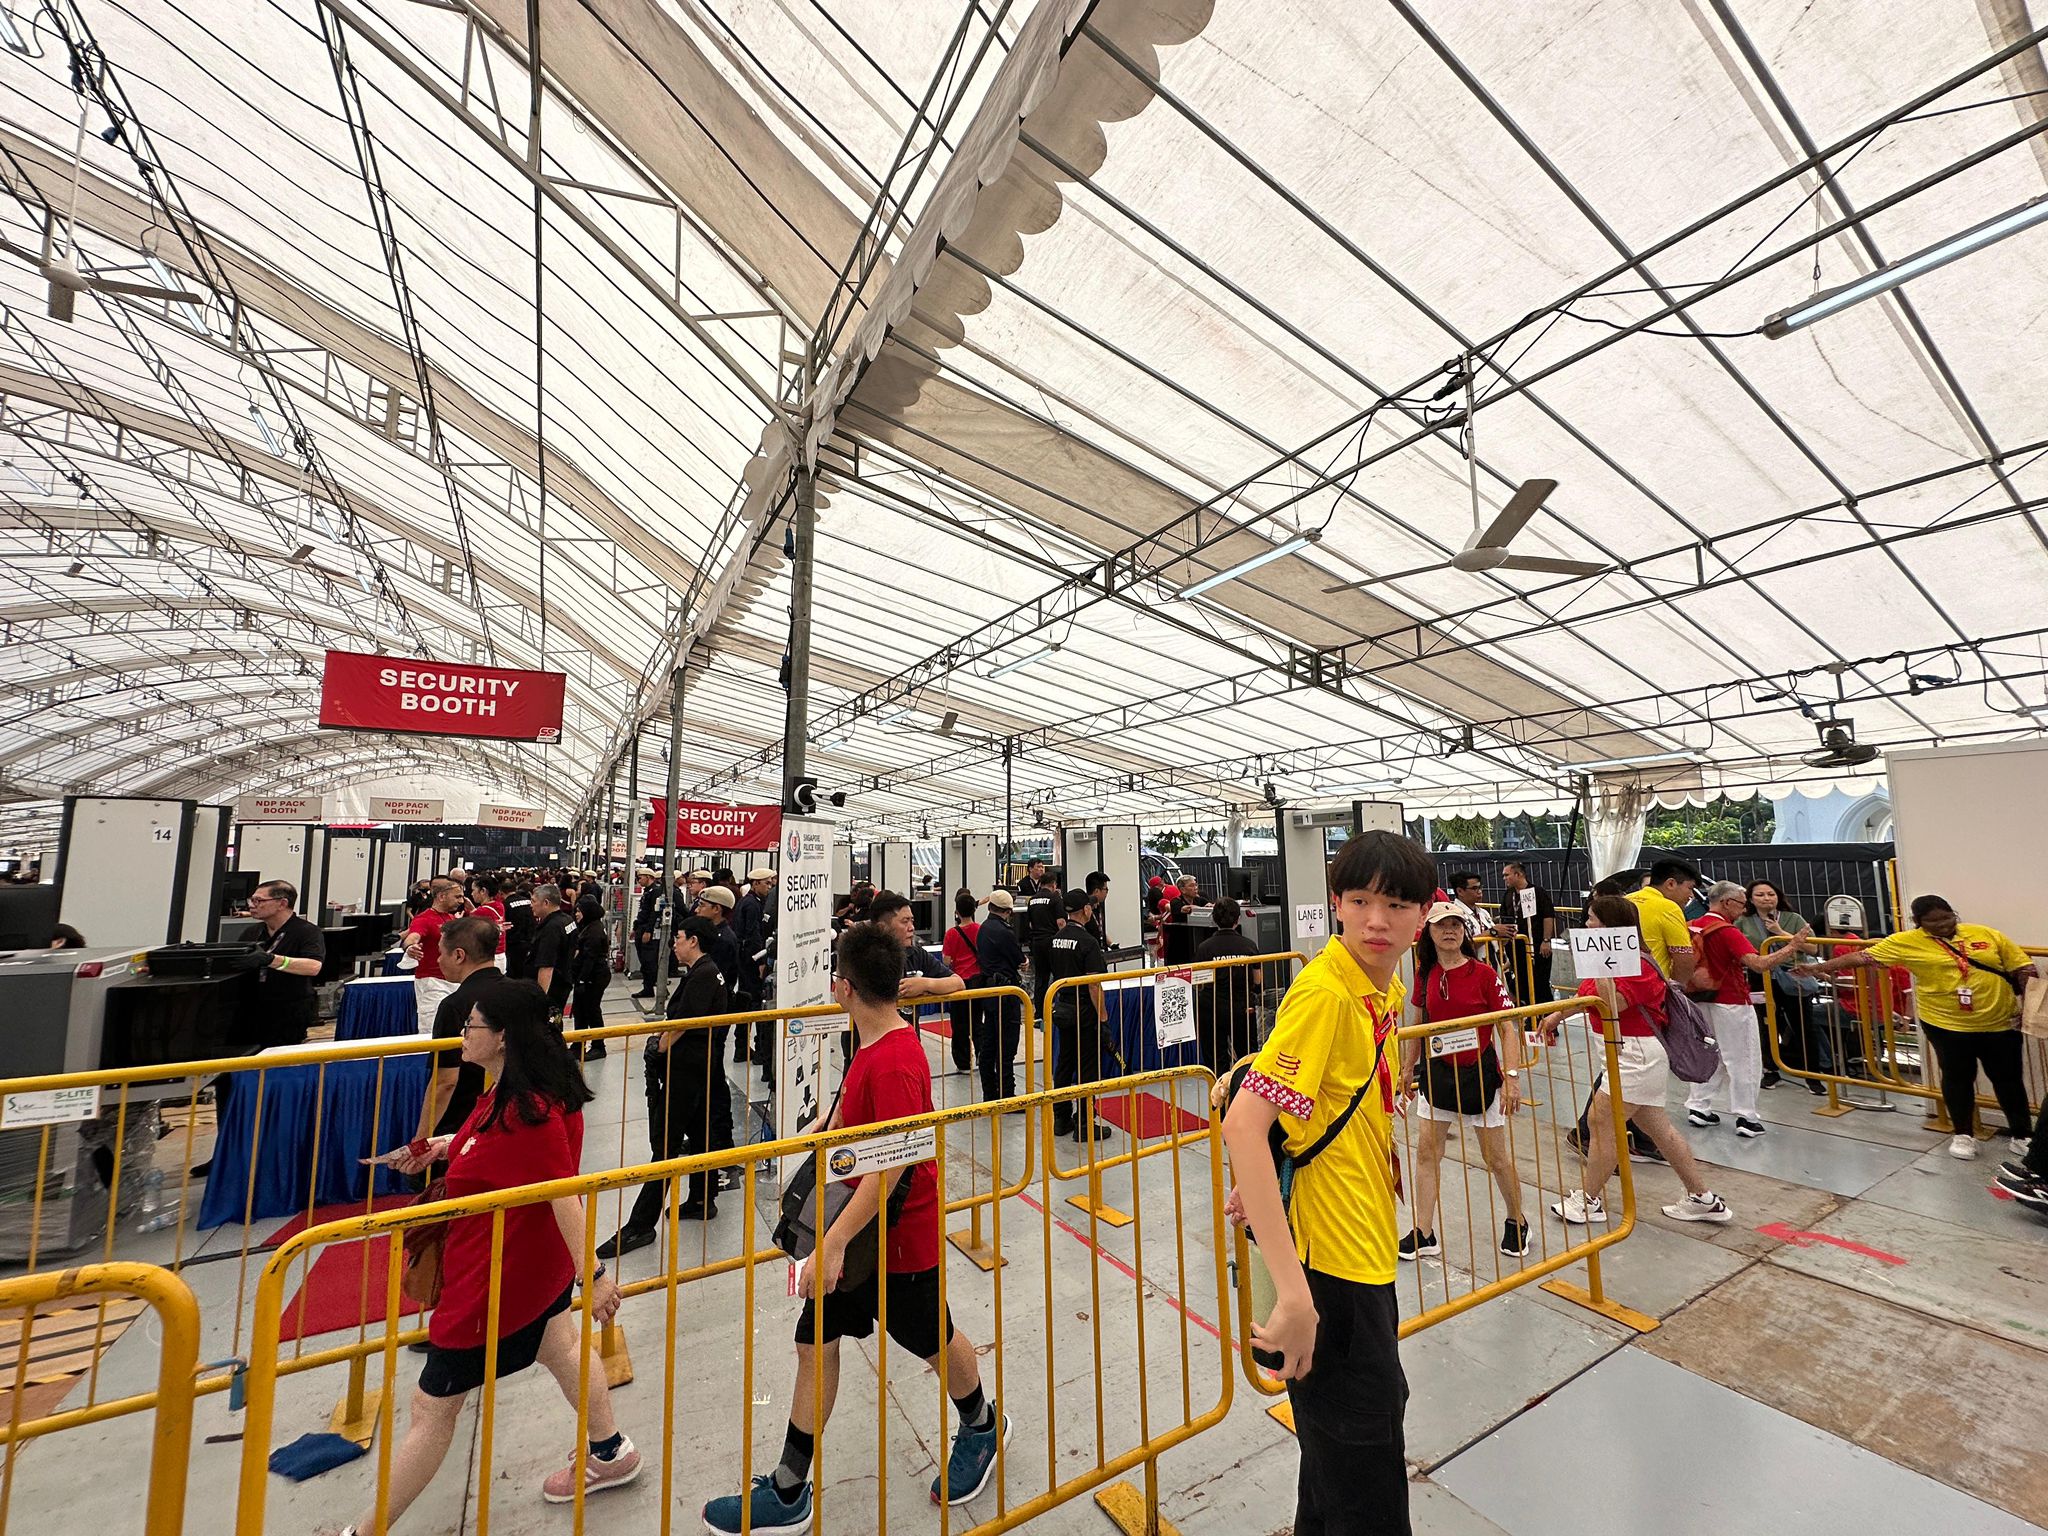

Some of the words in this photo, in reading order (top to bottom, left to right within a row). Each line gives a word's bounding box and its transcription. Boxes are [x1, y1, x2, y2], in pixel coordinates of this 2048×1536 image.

[379, 668, 520, 697] SECURITY
[400, 693, 497, 717] BOOTH
[498, 815, 525, 823] BOOTH
[678, 807, 758, 823] SECURITY
[154, 829, 171, 841] 14
[690, 823, 745, 837] BOOTH
[289, 844, 300, 852] 15
[1128, 844, 1133, 852] 2
[786, 873, 829, 892] SECURITY
[786, 893, 817, 912] CHECK
[1297, 910, 1317, 921] LANE
[1318, 908, 1324, 920] B
[1052, 938, 1078, 950] SECURITY
[1575, 936, 1622, 952] LANE
[1627, 934, 1638, 950] C
[55, 1089, 94, 1100] S-LITE
